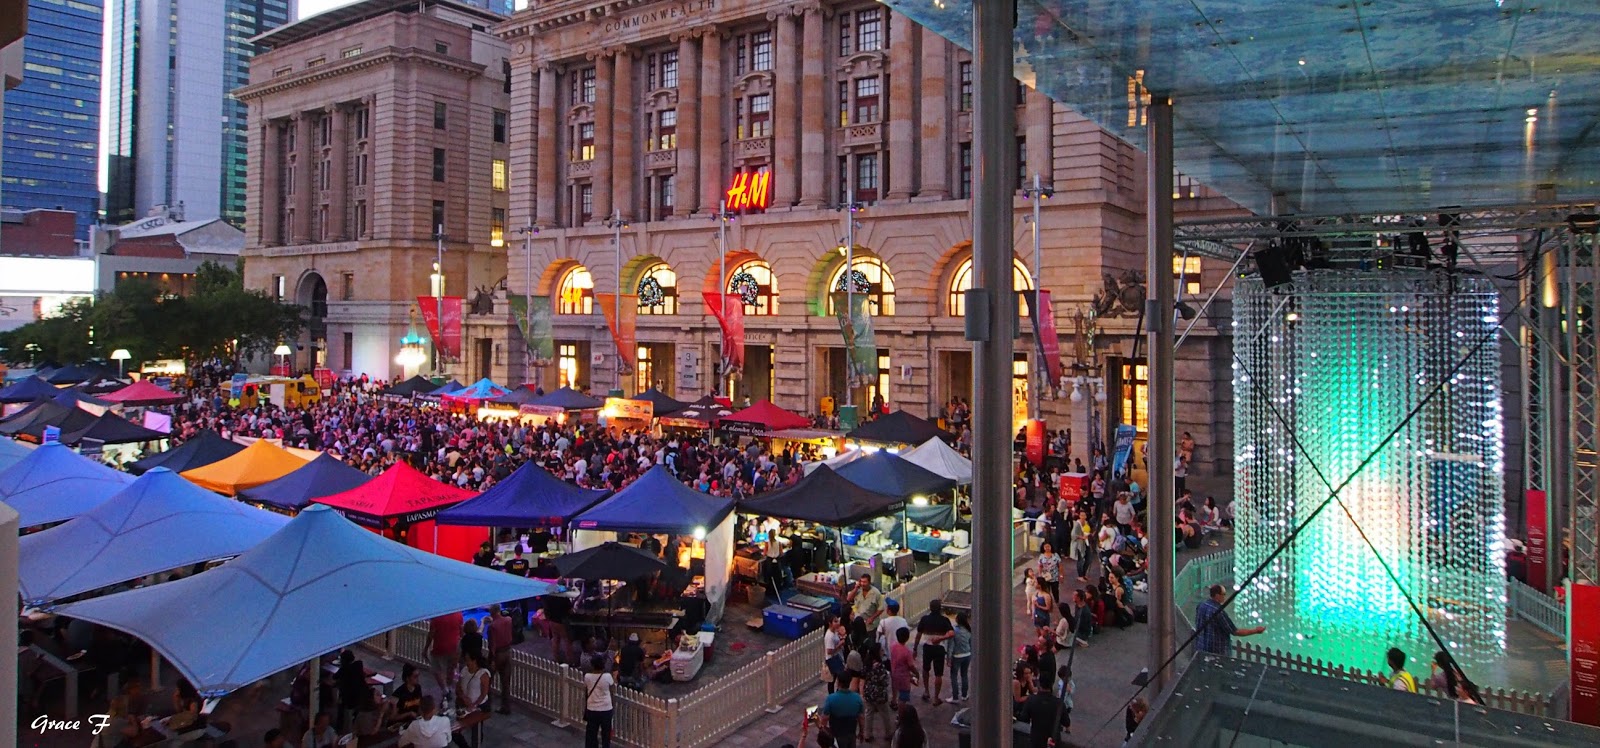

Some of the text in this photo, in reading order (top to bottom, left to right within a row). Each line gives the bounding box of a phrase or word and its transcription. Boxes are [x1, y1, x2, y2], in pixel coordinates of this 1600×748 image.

[605, 0, 715, 33] COMMONWEALTH
[727, 171, 770, 208] H&M
[406, 508, 440, 523] TAPASMA
